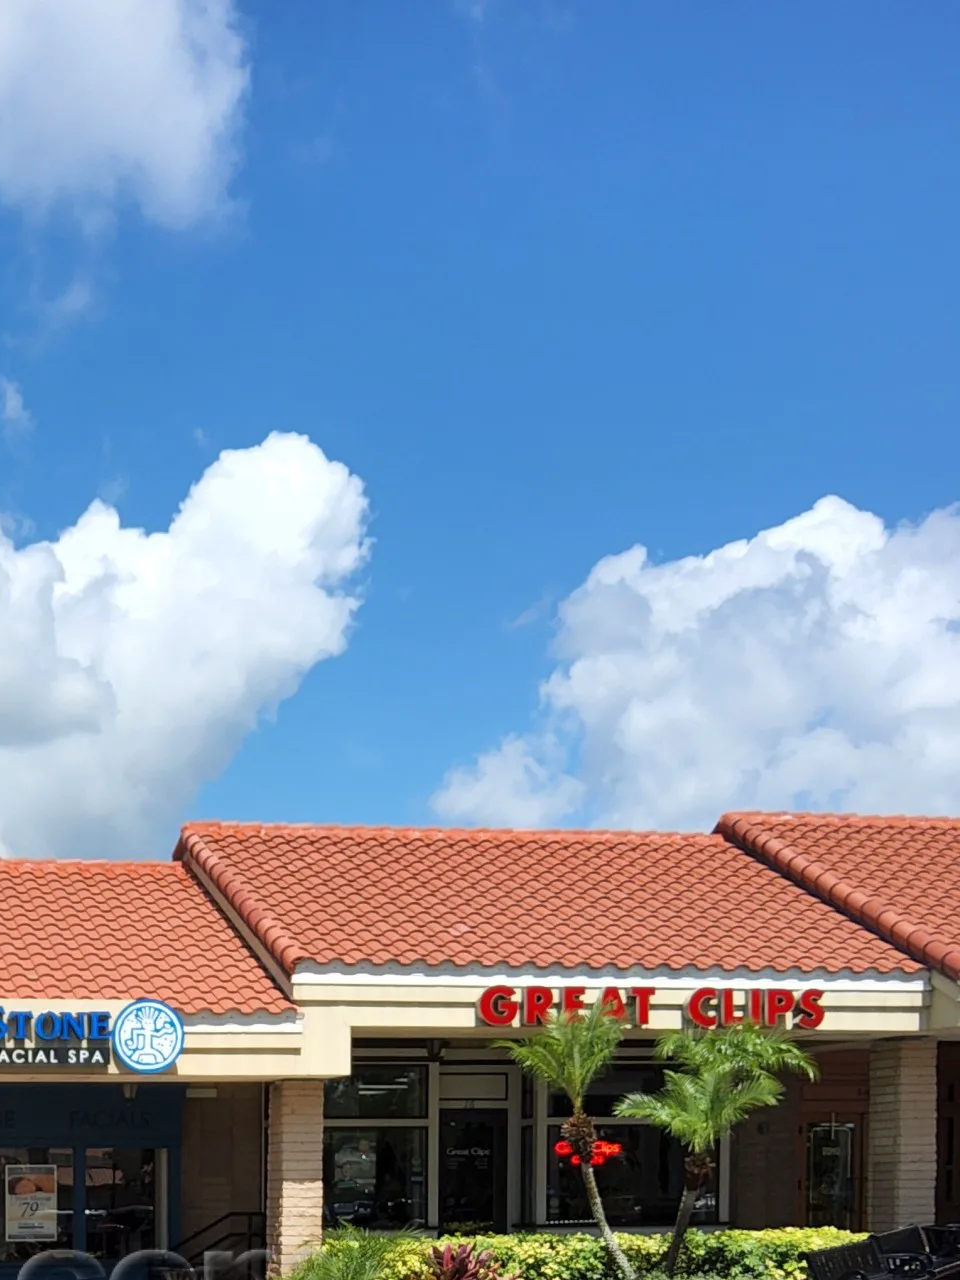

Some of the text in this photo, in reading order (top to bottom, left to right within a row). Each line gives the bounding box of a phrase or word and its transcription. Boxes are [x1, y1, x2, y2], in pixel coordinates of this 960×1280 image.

[479, 985, 826, 1029] GREAT CLIPS
[67, 1048, 106, 1065] SPA
[69, 1110, 151, 1129] FACIALS
